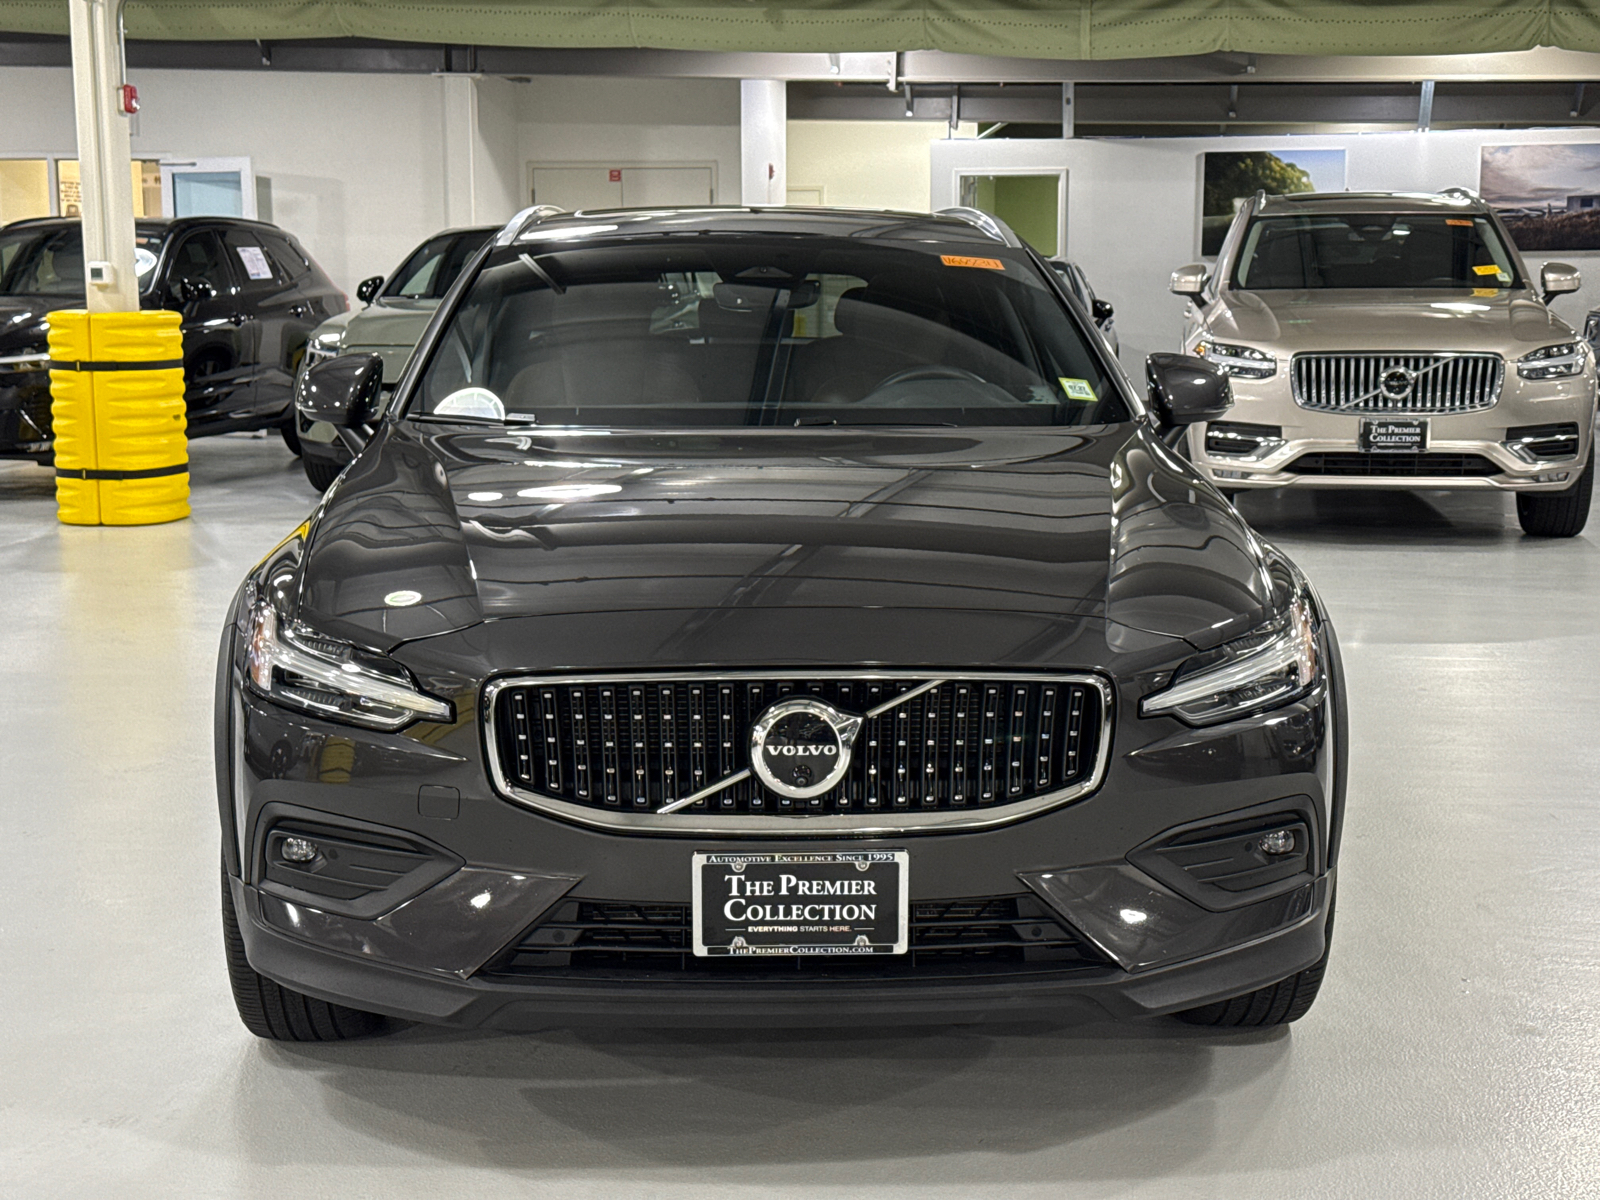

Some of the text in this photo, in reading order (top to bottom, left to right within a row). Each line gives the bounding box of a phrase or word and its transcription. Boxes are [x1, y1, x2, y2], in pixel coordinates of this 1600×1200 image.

[1370, 425, 1421, 433] THE PREMIER
[1369, 433, 1421, 442] COLLECTION
[766, 745, 837, 756] VOLVO
[708, 853, 894, 863] AUTOMOTIVE EXCELLENCE SINCE 1995
[724, 874, 877, 896] THE PREMIER
[723, 898, 877, 921] COLLECTION
